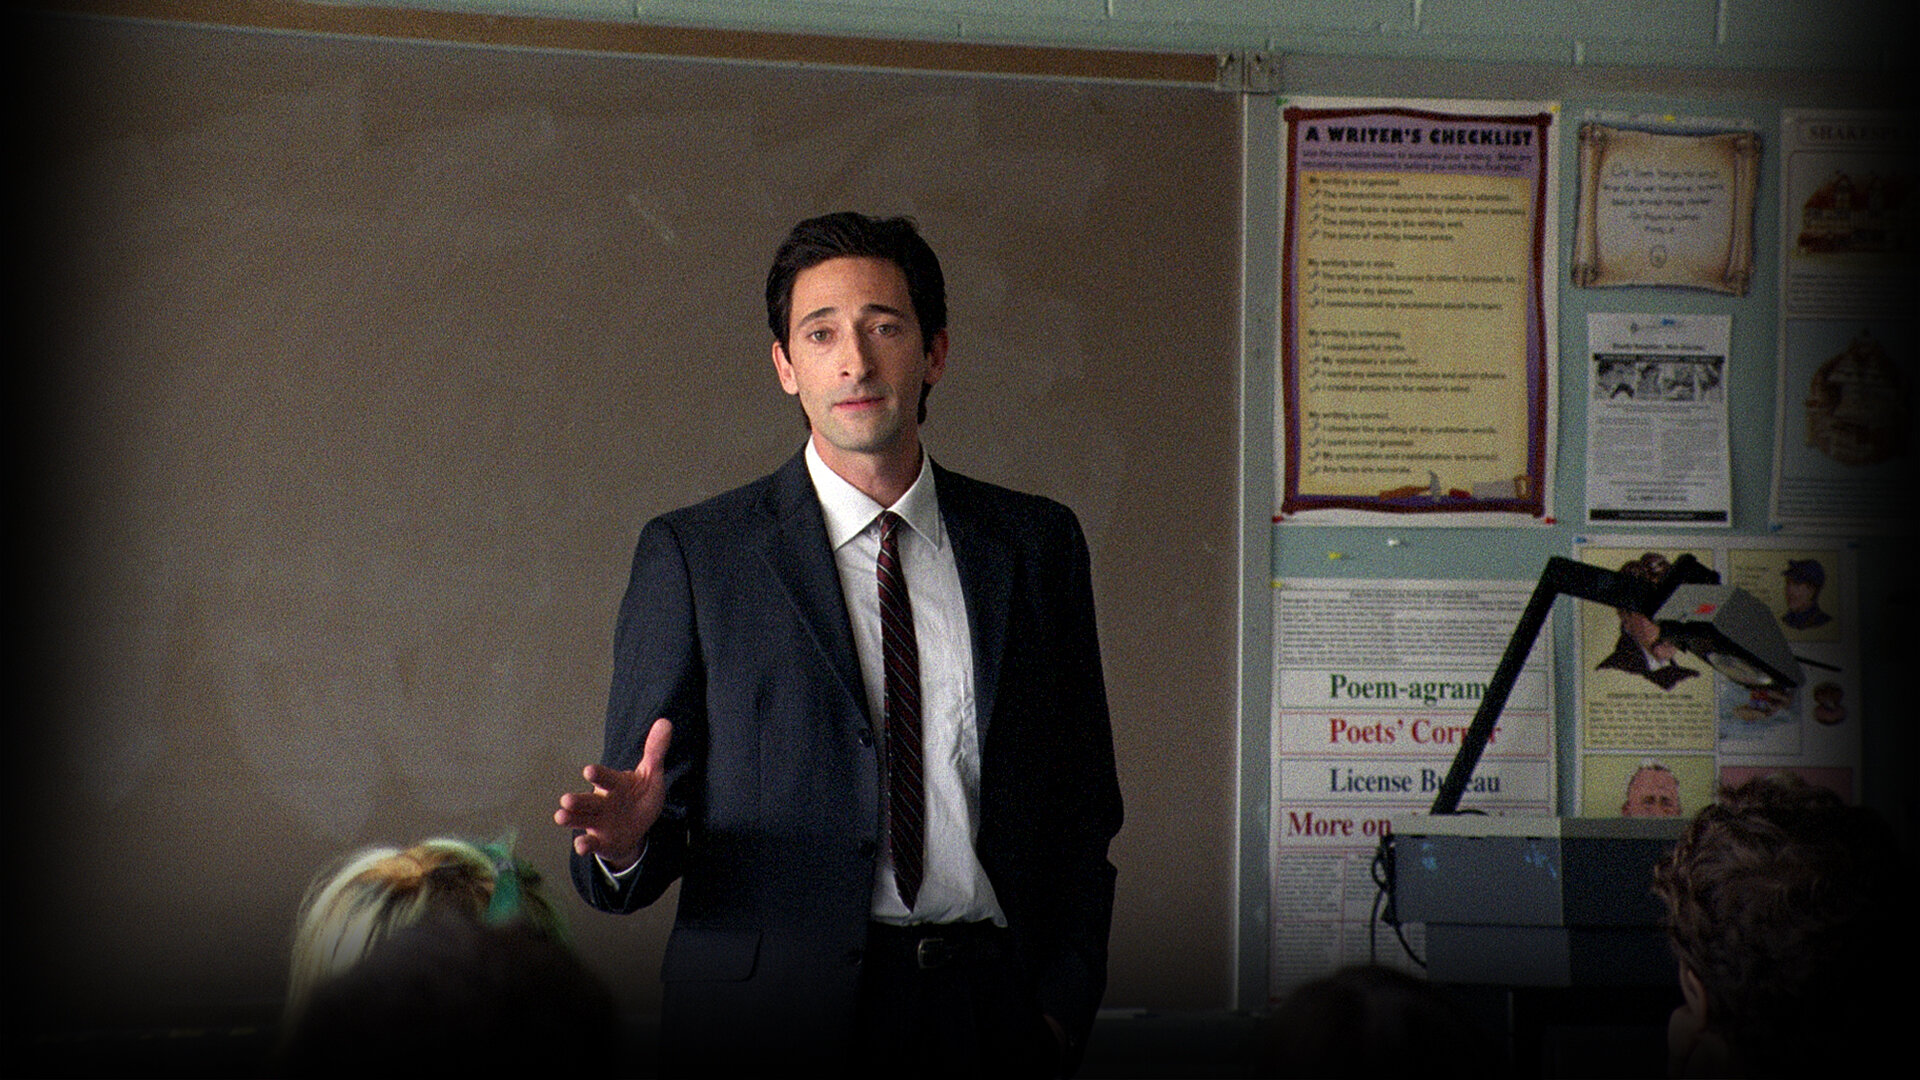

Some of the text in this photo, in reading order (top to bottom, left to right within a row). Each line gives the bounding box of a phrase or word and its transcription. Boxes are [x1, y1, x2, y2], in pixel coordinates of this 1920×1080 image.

[1306, 126, 1533, 147] A WRITER'S CHECKLIST
[1412, 719, 1502, 744] Corr
[1330, 768, 1501, 793] License Bau
[1288, 811, 1354, 837] More
